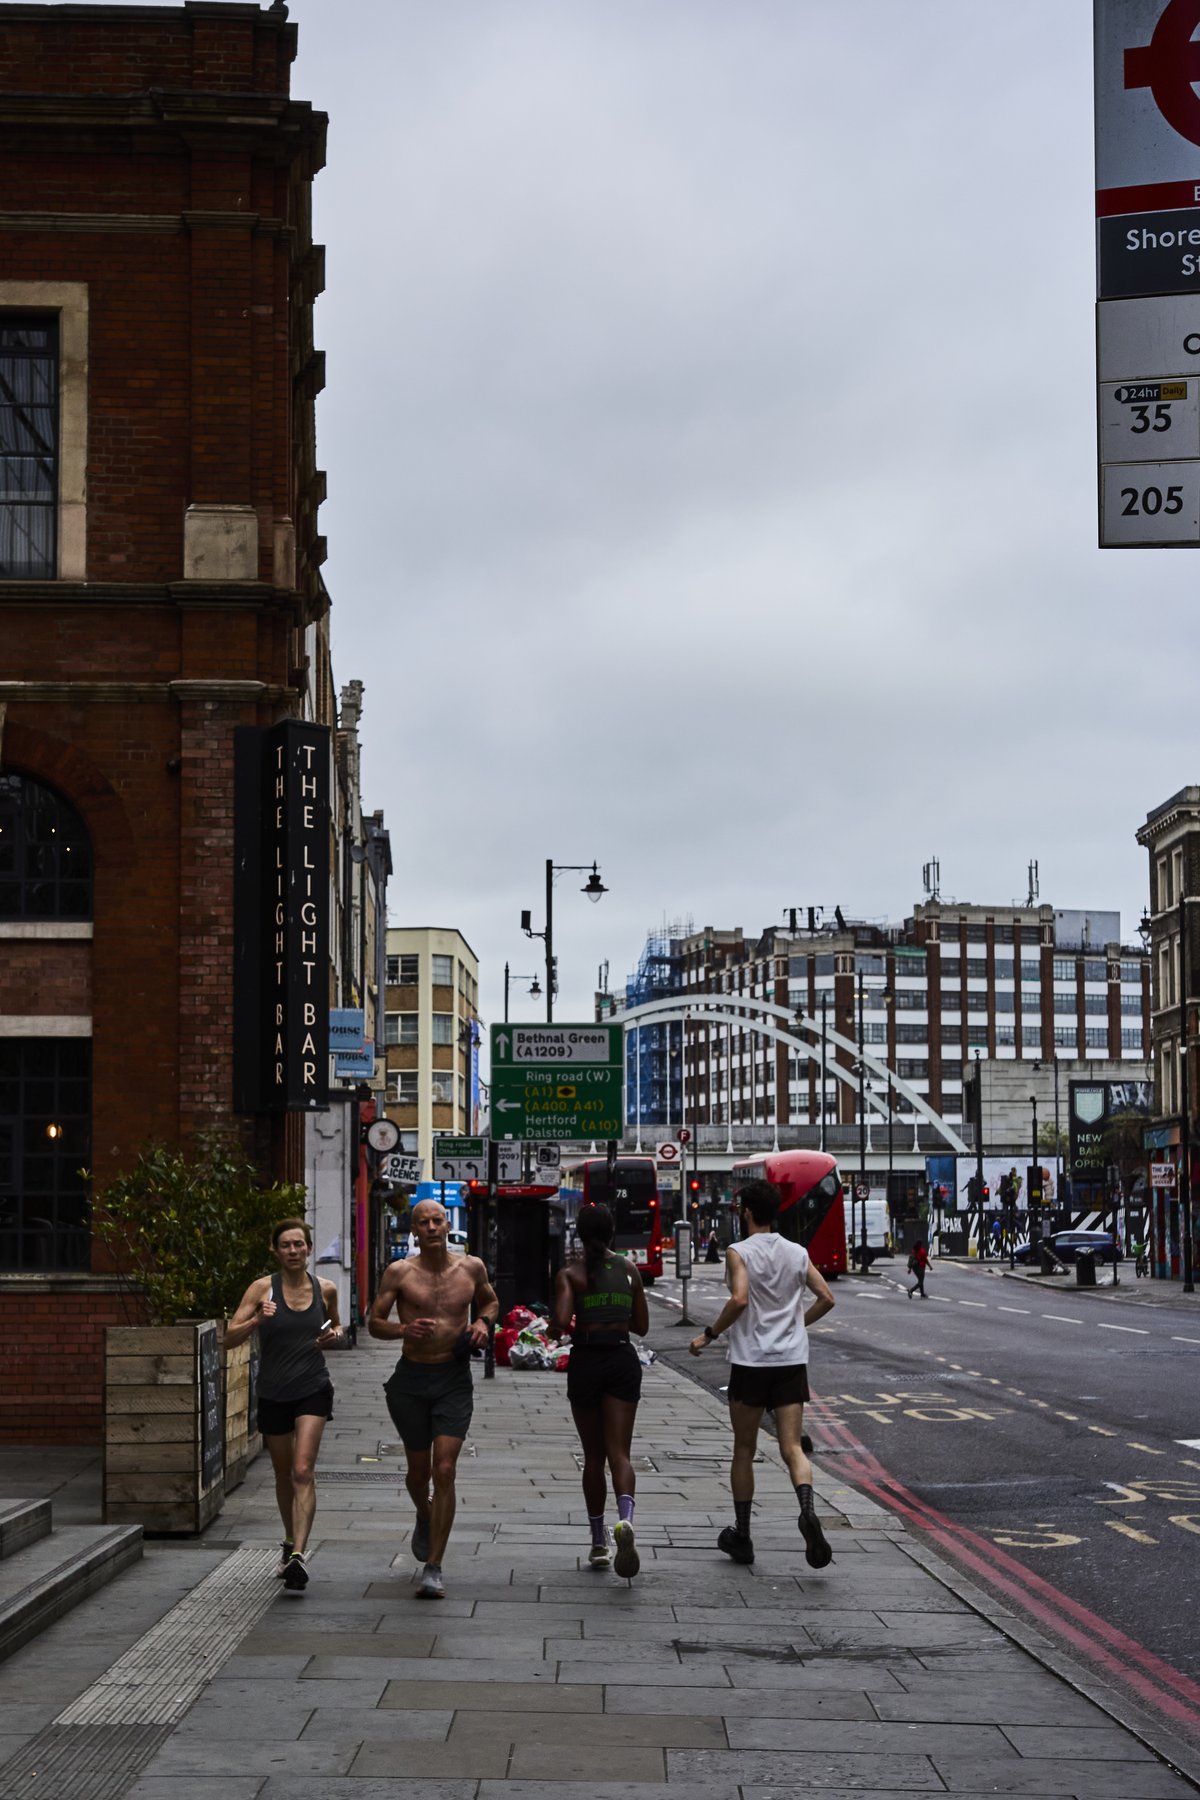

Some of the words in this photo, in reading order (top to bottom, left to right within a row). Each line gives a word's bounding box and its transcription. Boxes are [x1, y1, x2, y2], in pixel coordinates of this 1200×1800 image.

[1130, 387, 1160, 399] 24hr
[1162, 386, 1184, 396] Daily
[1130, 404, 1172, 434] 35
[1121, 485, 1184, 516] 205
[275, 745, 284, 829] THE
[302, 745, 316, 828] THE
[275, 846, 284, 985] LIGHT
[301, 845, 317, 985] LIGHT
[329, 1026, 360, 1035] ouse
[274, 1003, 283, 1084] BAR
[301, 1003, 316, 1085] BAR
[517, 1033, 564, 1043] Bethnal
[568, 1033, 605, 1043] Green
[516, 1046, 573, 1058] (A1209)
[526, 1071, 552, 1083] Ring
[556, 1071, 583, 1081] road
[586, 1070, 611, 1082] (W)
[524, 1087, 553, 1098] (A1)
[526, 1115, 577, 1125] Hertford
[581, 1120, 618, 1132] (A10)
[526, 1128, 572, 1138] Dalston
[1077, 1134, 1103, 1143] NEW
[1079, 1147, 1102, 1156] BAR
[391, 1158, 418, 1170] OFF
[1075, 1160, 1105, 1168] OPEN
[616, 1189, 627, 1198] 78
[857, 1187, 867, 1195] 20
